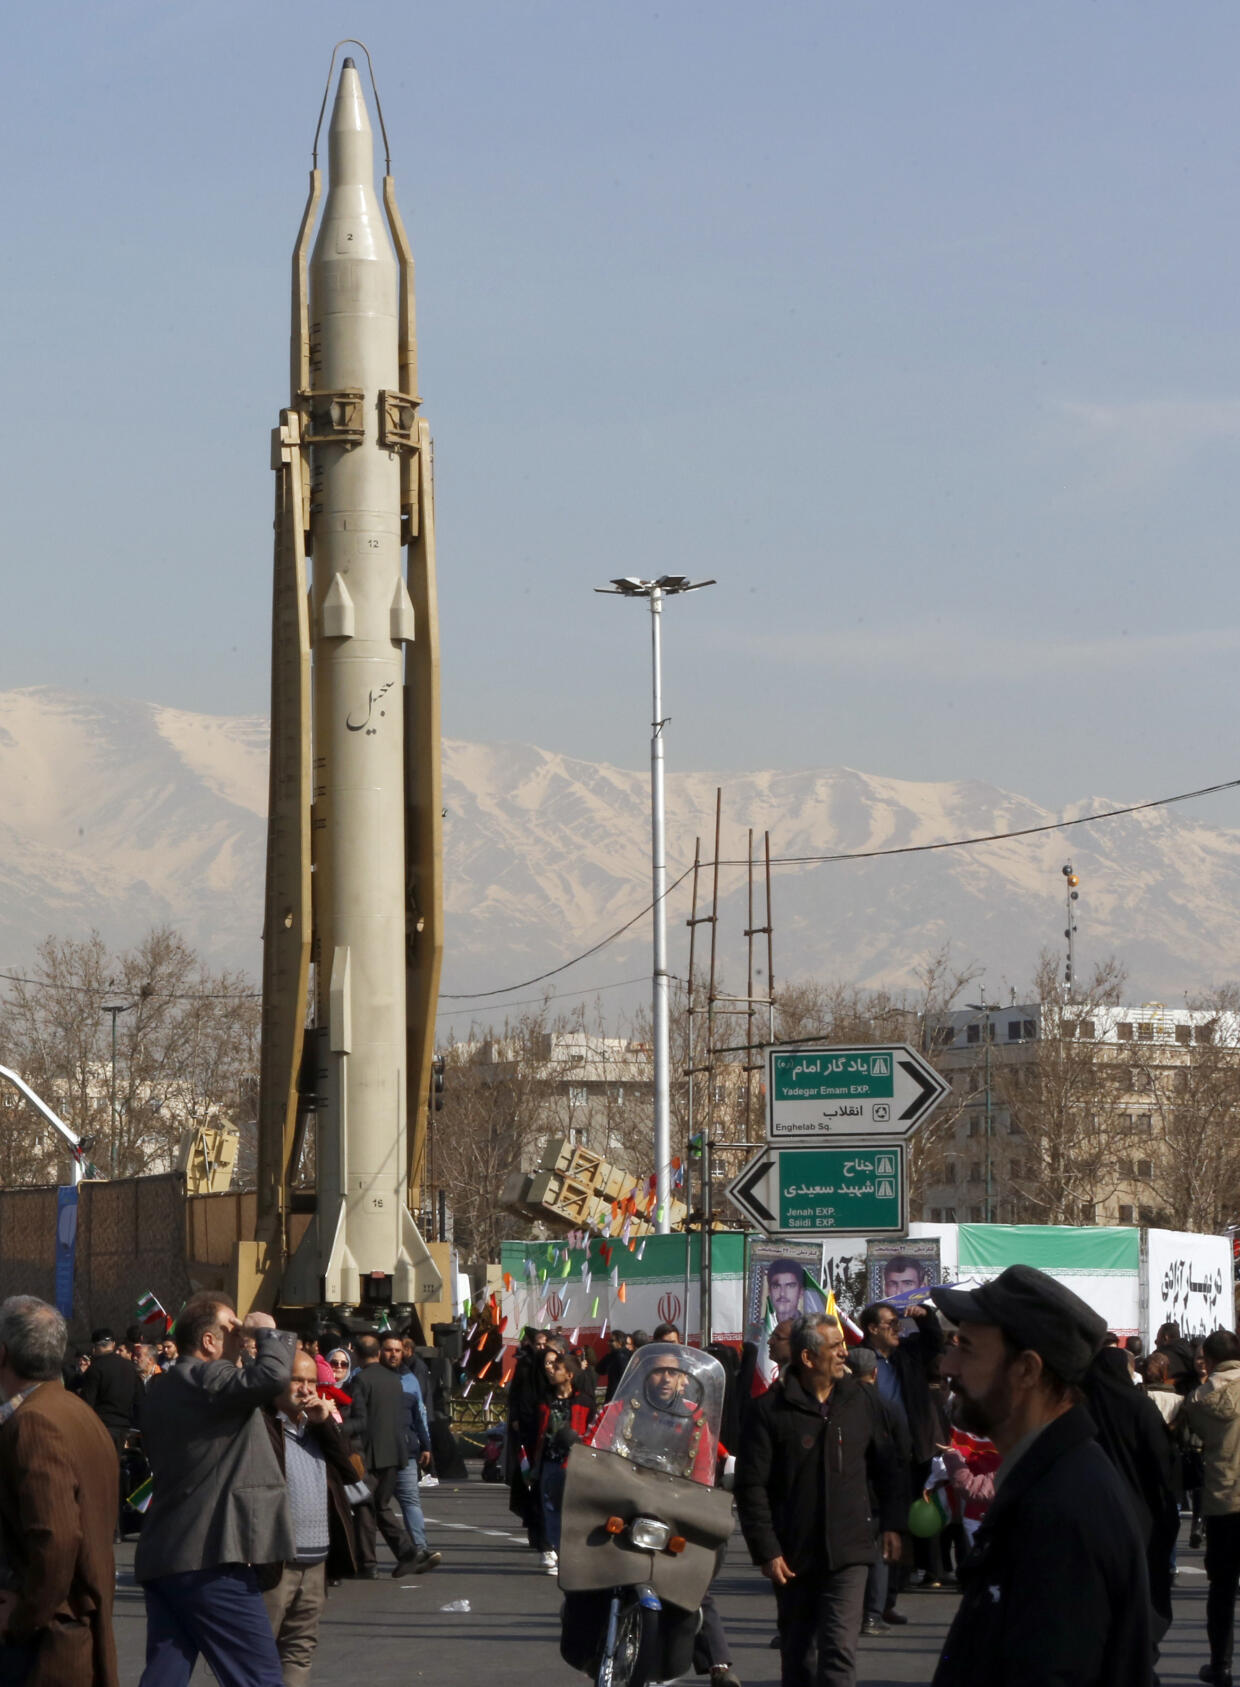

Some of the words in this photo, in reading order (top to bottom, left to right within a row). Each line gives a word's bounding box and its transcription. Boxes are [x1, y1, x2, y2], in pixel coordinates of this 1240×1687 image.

[367, 539, 380, 548] 12
[346, 681, 394, 736] سجیل
[792, 1059, 820, 1081] امام
[782, 1087, 818, 1097] Yadegar
[820, 1086, 848, 1095] Emam
[850, 1085, 871, 1094] EXP.
[823, 1105, 863, 1120] انقلاب
[775, 1122, 816, 1132] Enghelab
[818, 1123, 832, 1132] Sq.
[843, 1158, 874, 1177] جناح
[783, 1183, 834, 1198] سعیدی
[837, 1180, 874, 1197] شهید
[786, 1207, 813, 1216] Jenah
[815, 1207, 836, 1216] EXP.
[788, 1218, 811, 1227] Saidi
[815, 1218, 836, 1227] EXP.
